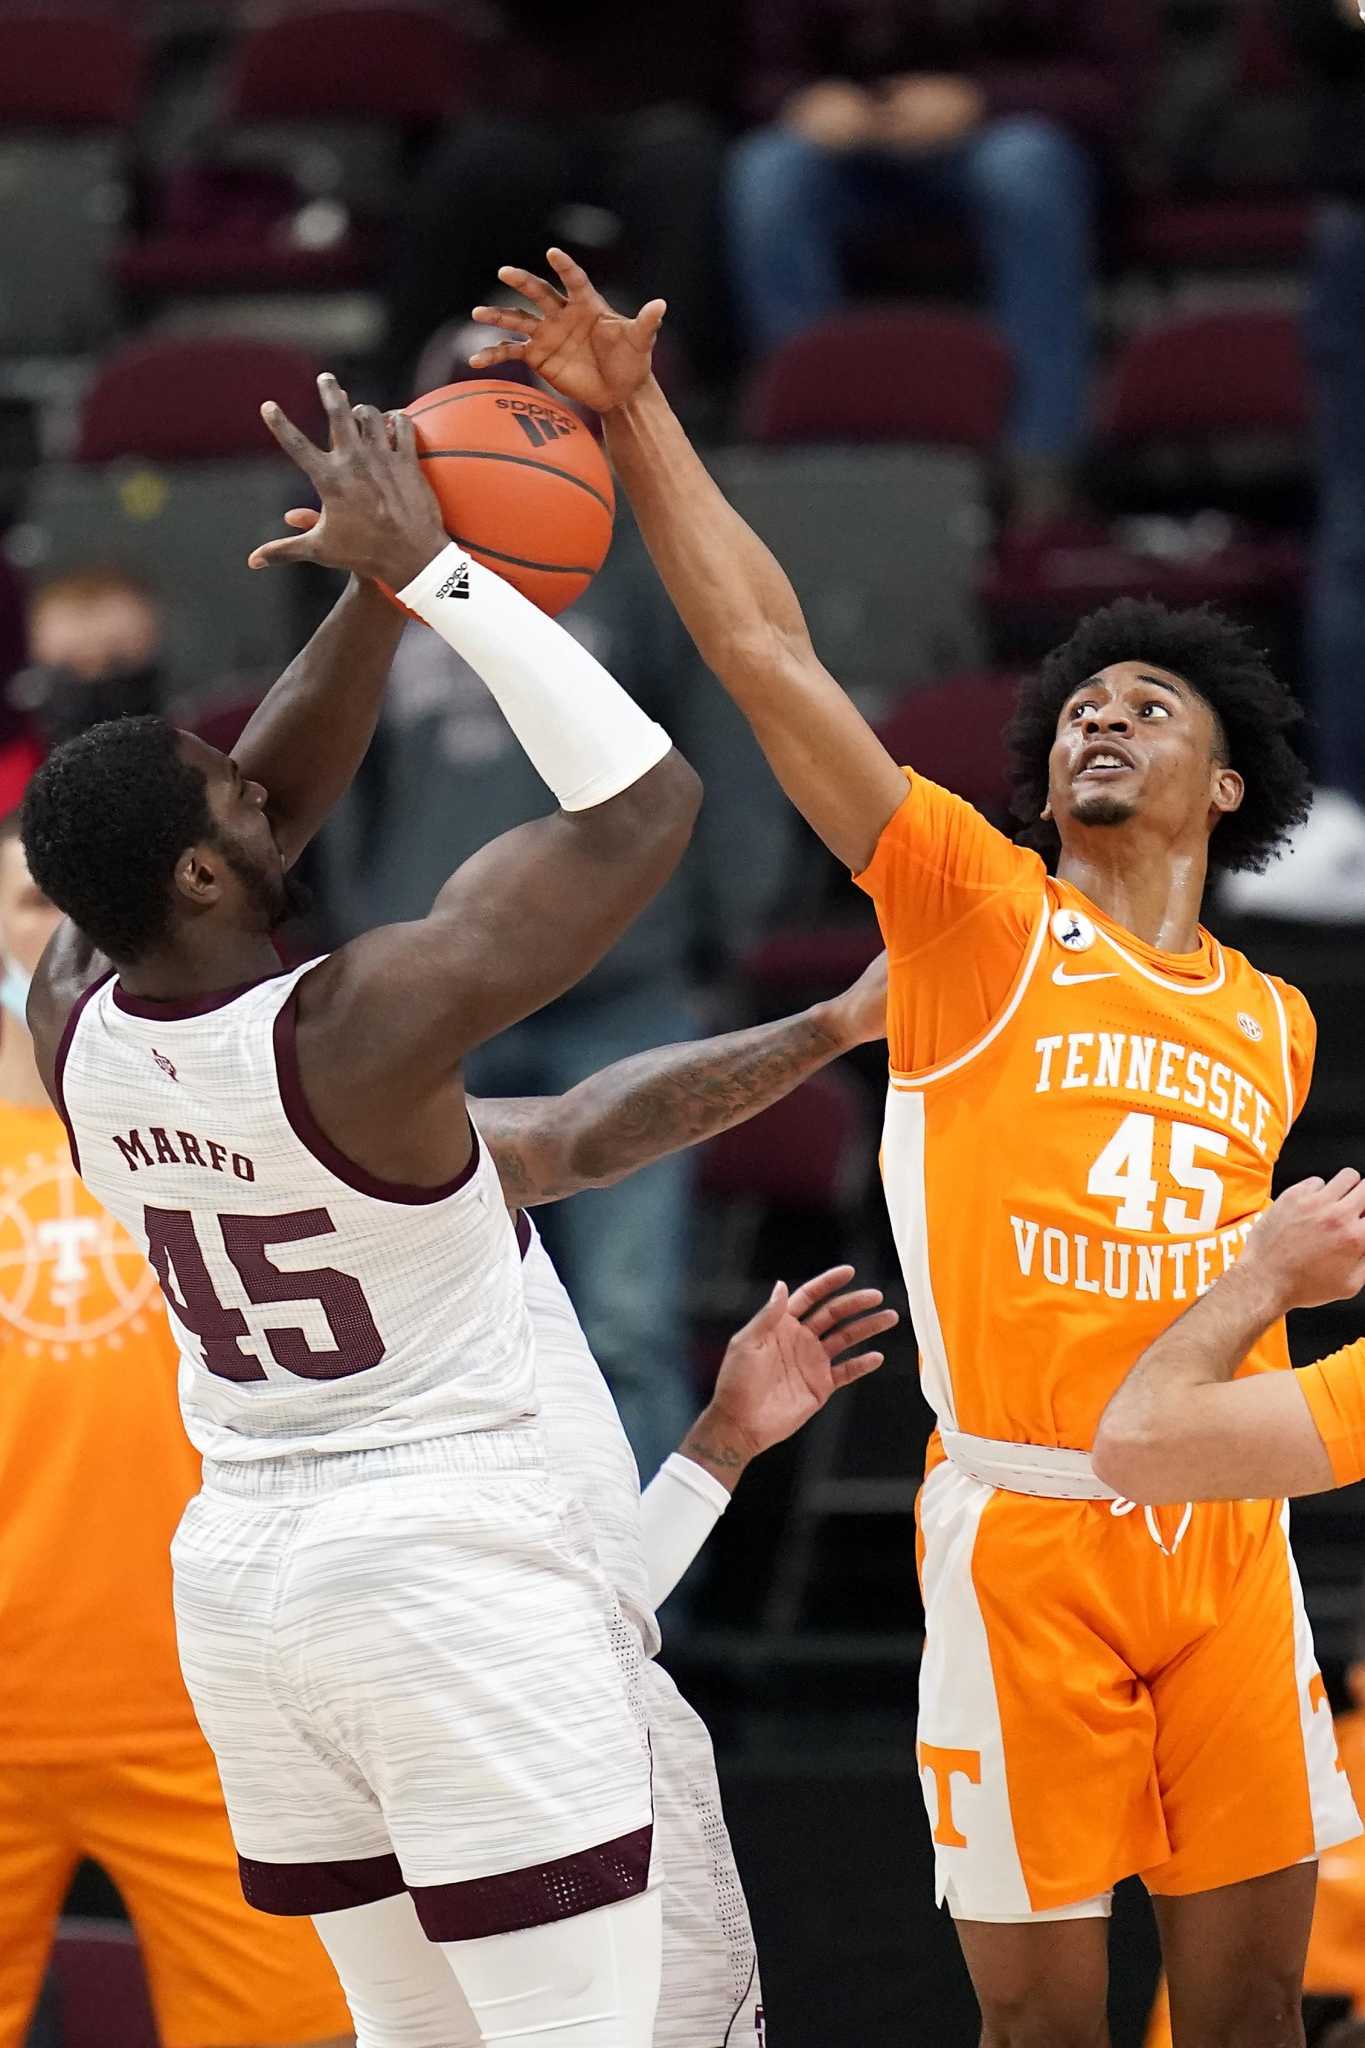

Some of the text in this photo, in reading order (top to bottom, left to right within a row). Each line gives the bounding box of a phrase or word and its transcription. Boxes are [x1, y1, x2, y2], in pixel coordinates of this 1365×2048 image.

[496, 399, 577, 430] adidas
[436, 562, 467, 599] adidas
[1035, 1033, 1272, 1153] TENNESSEE
[113, 1127, 255, 1182] MARFO
[1087, 1112, 1229, 1234] 45
[144, 1204, 386, 1382] 45
[1010, 1213, 1262, 1301] VOLUNTEE
[919, 1741, 981, 1849] T
